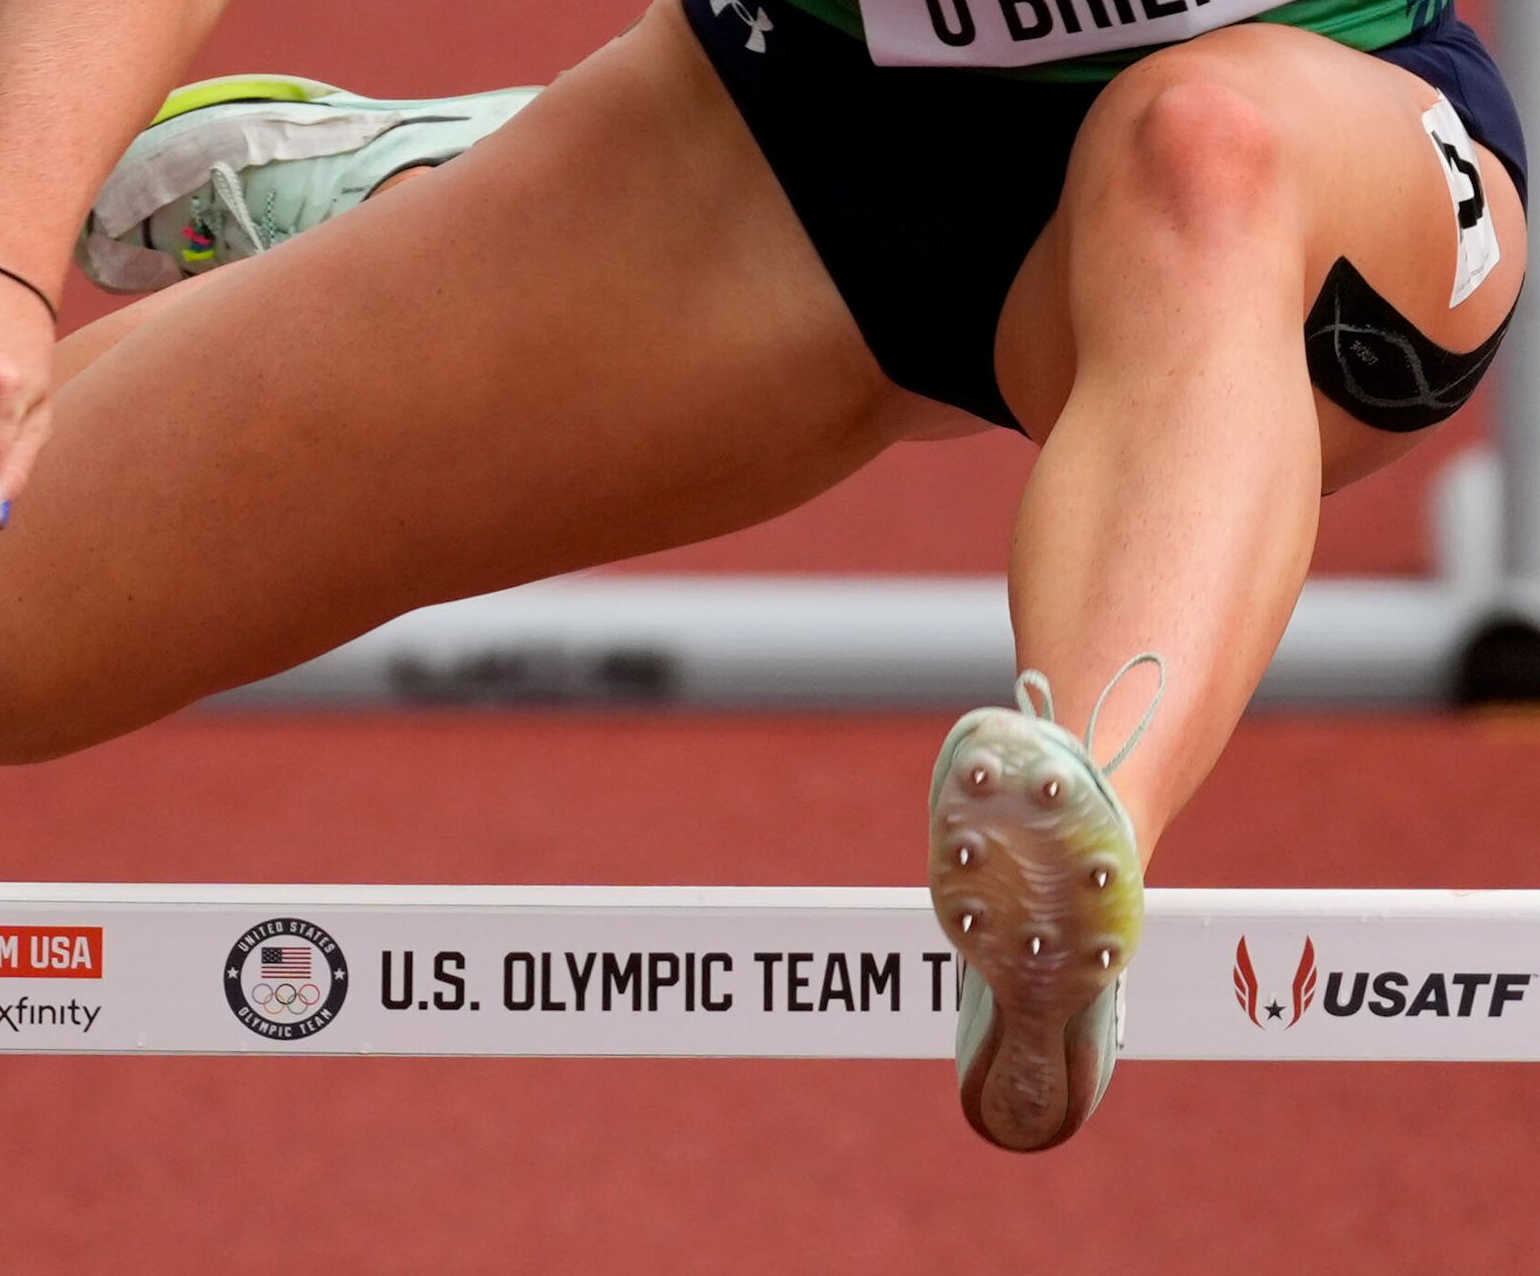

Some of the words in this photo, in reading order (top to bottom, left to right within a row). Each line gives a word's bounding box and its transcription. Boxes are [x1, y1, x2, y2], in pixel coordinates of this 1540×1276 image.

[30, 935, 93, 970] USA
[237, 921, 284, 953] UNITED
[289, 921, 336, 955] STATES
[381, 950, 481, 1012] U.S.
[503, 951, 734, 1012] OLYMPIC
[753, 952, 901, 1013] TEAM
[1323, 971, 1532, 1018] USATF
[237, 1006, 293, 1038] OLYMPIC
[298, 1008, 333, 1035] TEAM
